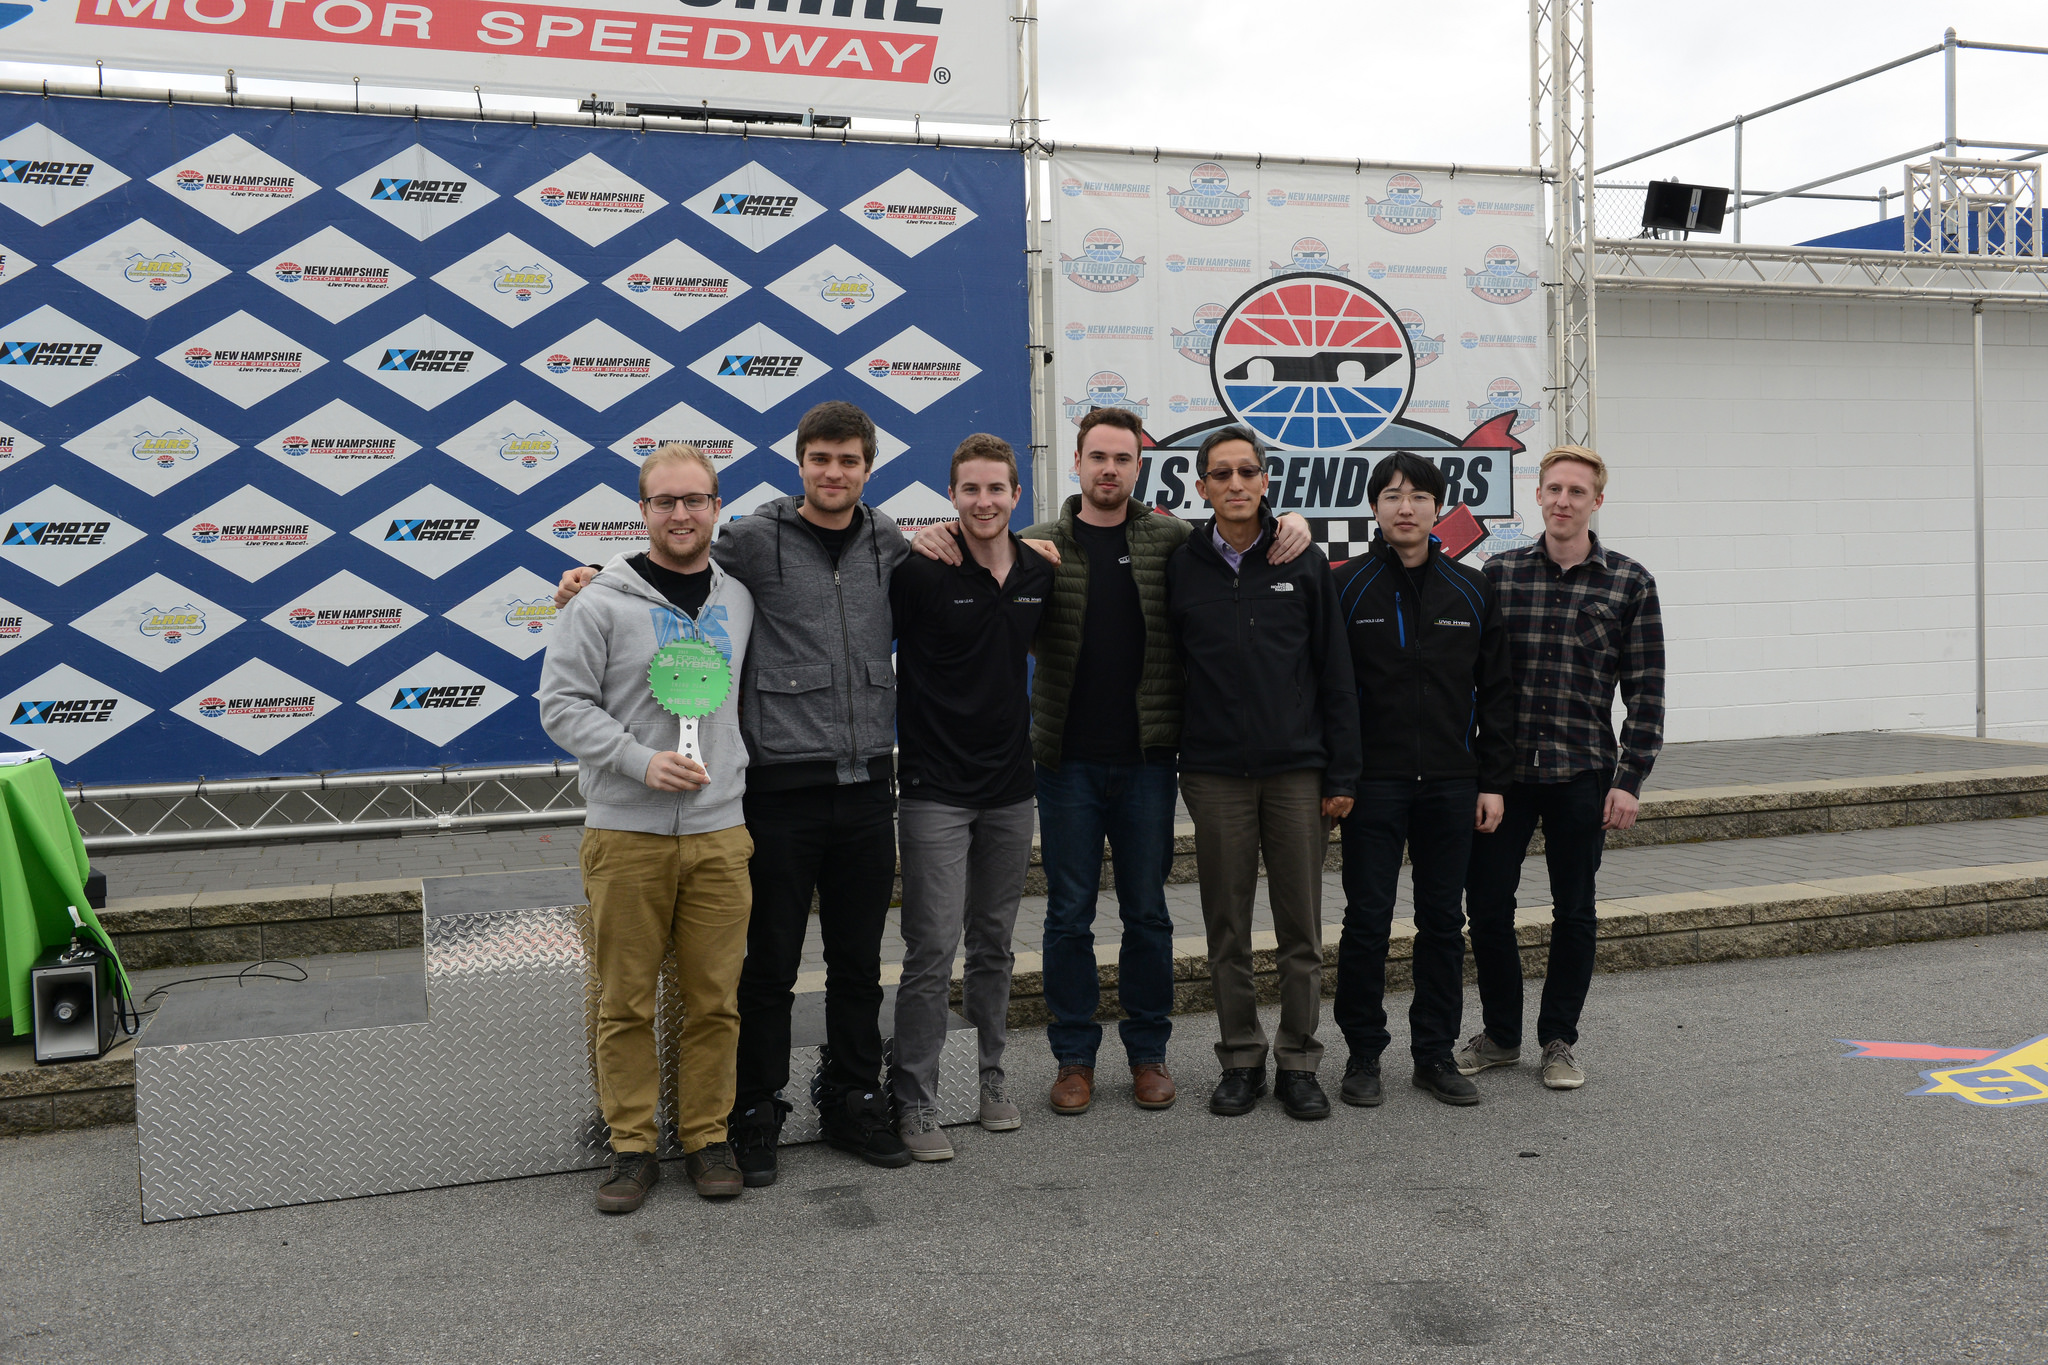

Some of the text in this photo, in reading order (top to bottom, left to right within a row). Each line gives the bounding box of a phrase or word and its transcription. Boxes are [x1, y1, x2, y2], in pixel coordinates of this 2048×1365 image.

[95, 0, 433, 40] MOTOR
[476, 11, 926, 73] SPEEDWAY
[29, 161, 94, 175] MOTO
[23, 173, 88, 186] RACE
[206, 174, 294, 186] NEW HAMPSHIRE
[410, 180, 467, 192] MOTO
[1084, 181, 1150, 193] NEW HAMPSHIRE
[404, 191, 461, 203] RACE
[567, 191, 644, 202] NEW HAMPSHIRE
[747, 195, 798, 206] MOTO
[1288, 192, 1350, 202] NEW HAMPSHIRE
[1189, 196, 1219, 208] LEGEND
[1222, 198, 1244, 209] CARS
[1477, 201, 1534, 211] NEW HAMPSHIRE
[742, 206, 793, 216] RACE
[887, 205, 956, 215] NEW HAMPSHIRE
[1385, 206, 1414, 217] LEGEND
[1416, 208, 1437, 218] CARS
[136, 261, 183, 272] LRRS
[1187, 257, 1251, 267] NEW HAMPSHIRE
[304, 266, 389, 277] NEW HAMPSHIRE
[1082, 263, 1114, 274] LEGEND
[1116, 264, 1140, 275] CARS
[1388, 264, 1447, 274] NEW HAMPSHIRE
[504, 273, 546, 284] LRRS
[653, 277, 728, 287] NEW HAMPSHIRE
[1483, 277, 1510, 288] LEGEND
[1513, 278, 1533, 288] CARS
[830, 283, 868, 292] LRRS
[1087, 325, 1154, 334] NEW HAMPSHIRE
[38, 343, 103, 354] MOTO
[1420, 342, 1439, 352] CARS
[32, 355, 96, 366] RACE
[214, 351, 302, 361] NEW HAMPSHIRE
[417, 350, 474, 361] MOTO
[752, 356, 803, 366] MOTO
[411, 361, 468, 372] RACE
[573, 358, 650, 366] NEW HAMPSHIRE
[747, 367, 798, 376] RACE
[1190, 398, 1208, 406] NEW
[143, 439, 191, 449] LRRS
[311, 439, 395, 448] NEW HAMPSHIRE
[510, 441, 552, 450] LRRS
[46, 522, 111, 533] MOTO
[222, 525, 308, 534] NEW HAMPSHIRE
[423, 519, 480, 529] MOTO
[578, 521, 600, 530] NEW
[40, 534, 104, 544] RACE
[417, 531, 474, 540] RACE
[318, 608, 402, 619] NEW HAMPSHIRE
[515, 606, 556, 615] LRRS
[151, 614, 198, 625] LRRS
[676, 660, 720, 669] HYBRID
[429, 685, 486, 697] MOTO
[54, 699, 118, 711] MOTO
[228, 696, 315, 708] NEW HAMPSHIRE
[423, 697, 480, 708] RACE
[47, 711, 111, 723] RACE
